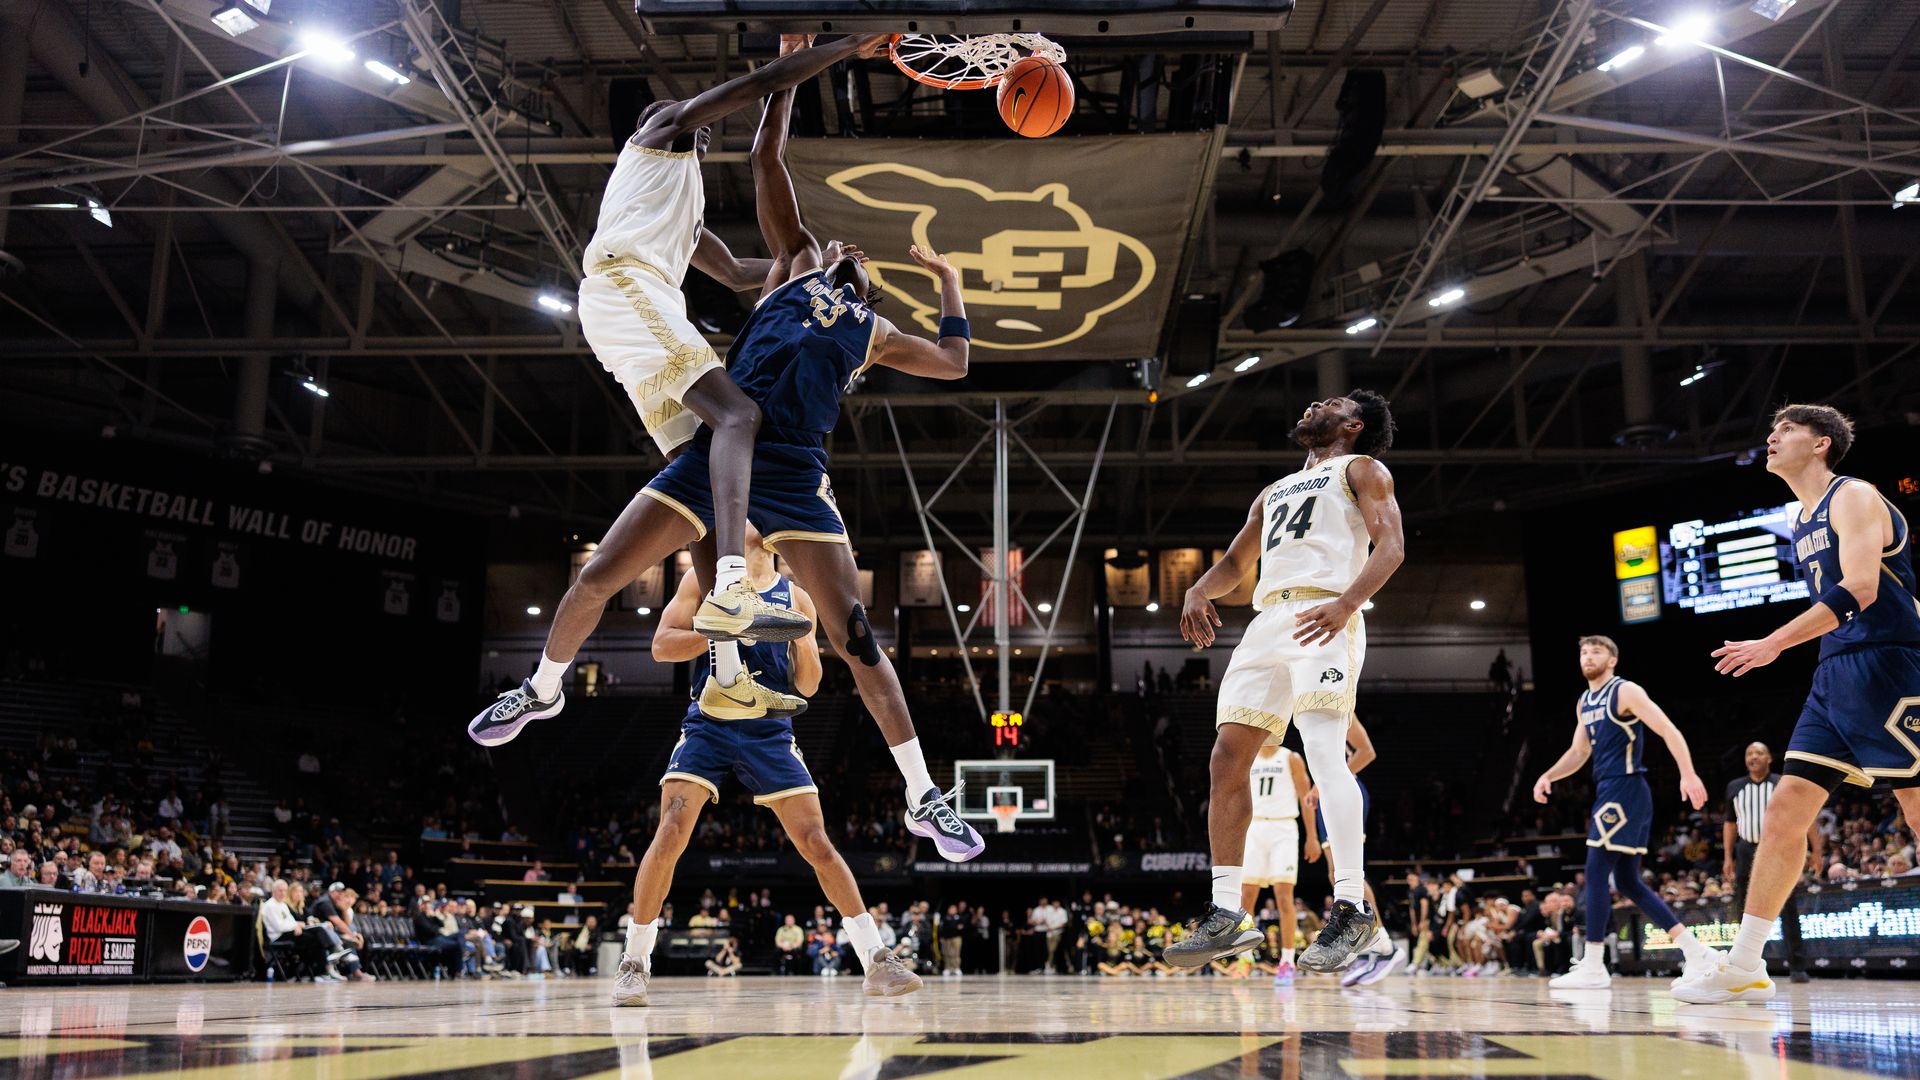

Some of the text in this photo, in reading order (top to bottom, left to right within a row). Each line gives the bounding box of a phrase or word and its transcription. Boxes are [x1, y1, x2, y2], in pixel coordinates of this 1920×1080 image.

[1267, 476, 1330, 506] COLORADO
[36, 469, 217, 528] BASKETBALL
[228, 503, 292, 541] WALL
[301, 518, 334, 547] OF
[338, 525, 418, 562] HONOR
[1266, 496, 1318, 552] 24
[1808, 560, 1823, 594] 7
[996, 727, 1018, 746] 14
[1259, 776, 1274, 797] 11
[1141, 853, 1211, 871] CUBUFFS.
[71, 906, 138, 935] BLACKJACK
[68, 937, 101, 964] PIZZA
[104, 943, 135, 960] & SALADS
[186, 938, 209, 949] PEPSI
